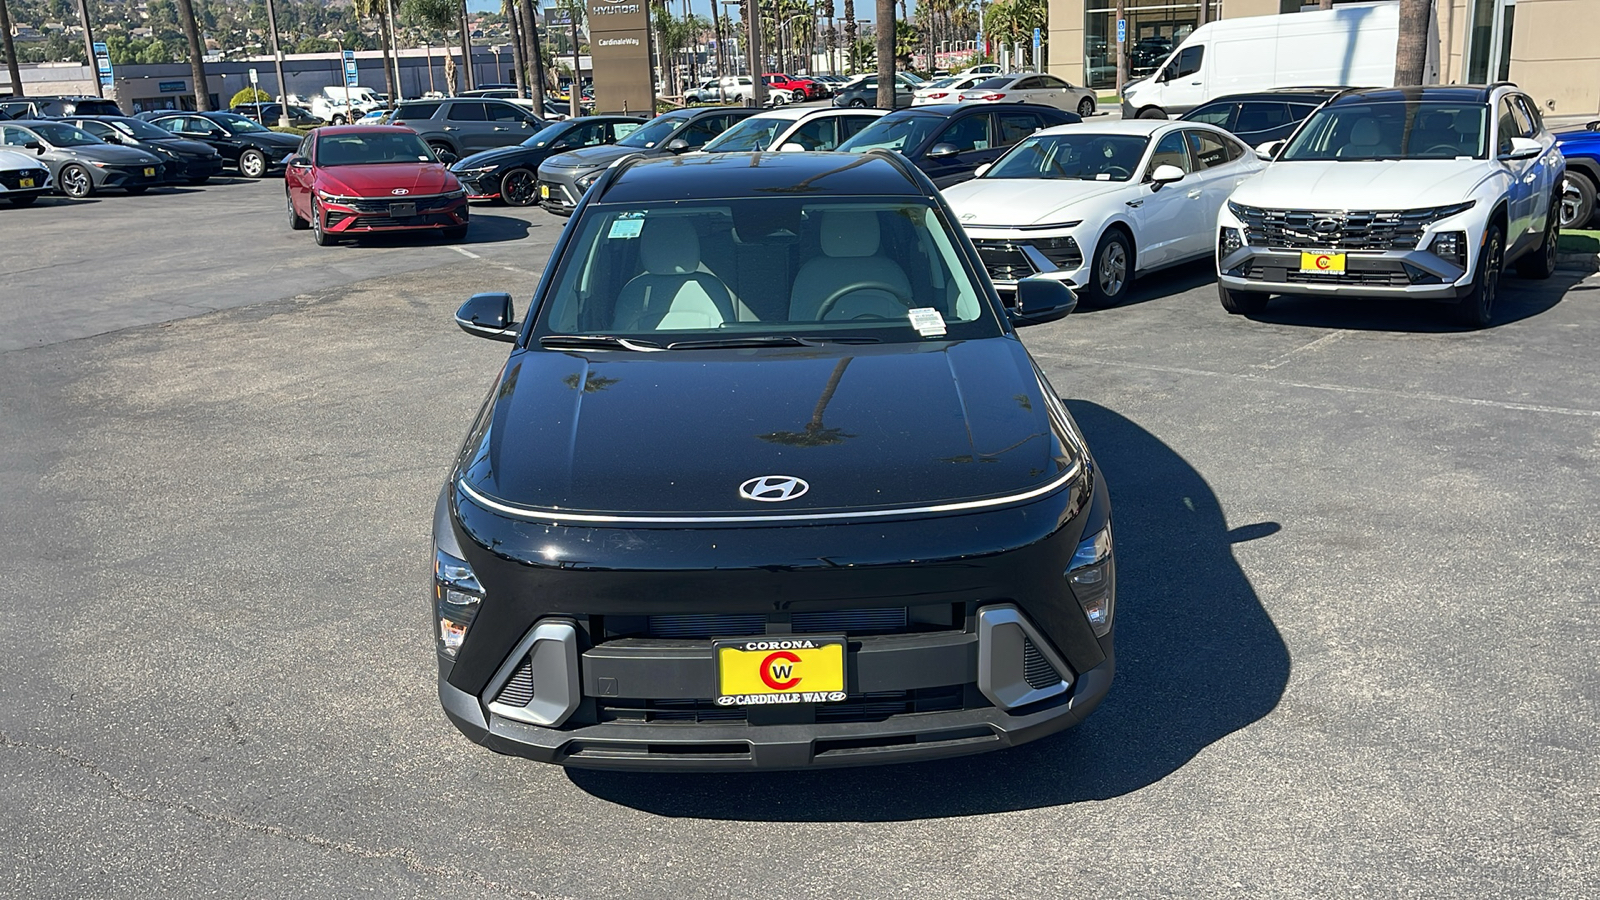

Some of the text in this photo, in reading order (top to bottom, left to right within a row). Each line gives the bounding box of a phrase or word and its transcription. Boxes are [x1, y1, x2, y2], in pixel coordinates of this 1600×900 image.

[593, 5, 639, 15] HYUNDAI
[598, 38, 639, 46] CardinaleWay
[746, 640, 815, 651] CORONA
[736, 692, 828, 705] CARDINALE WAY
